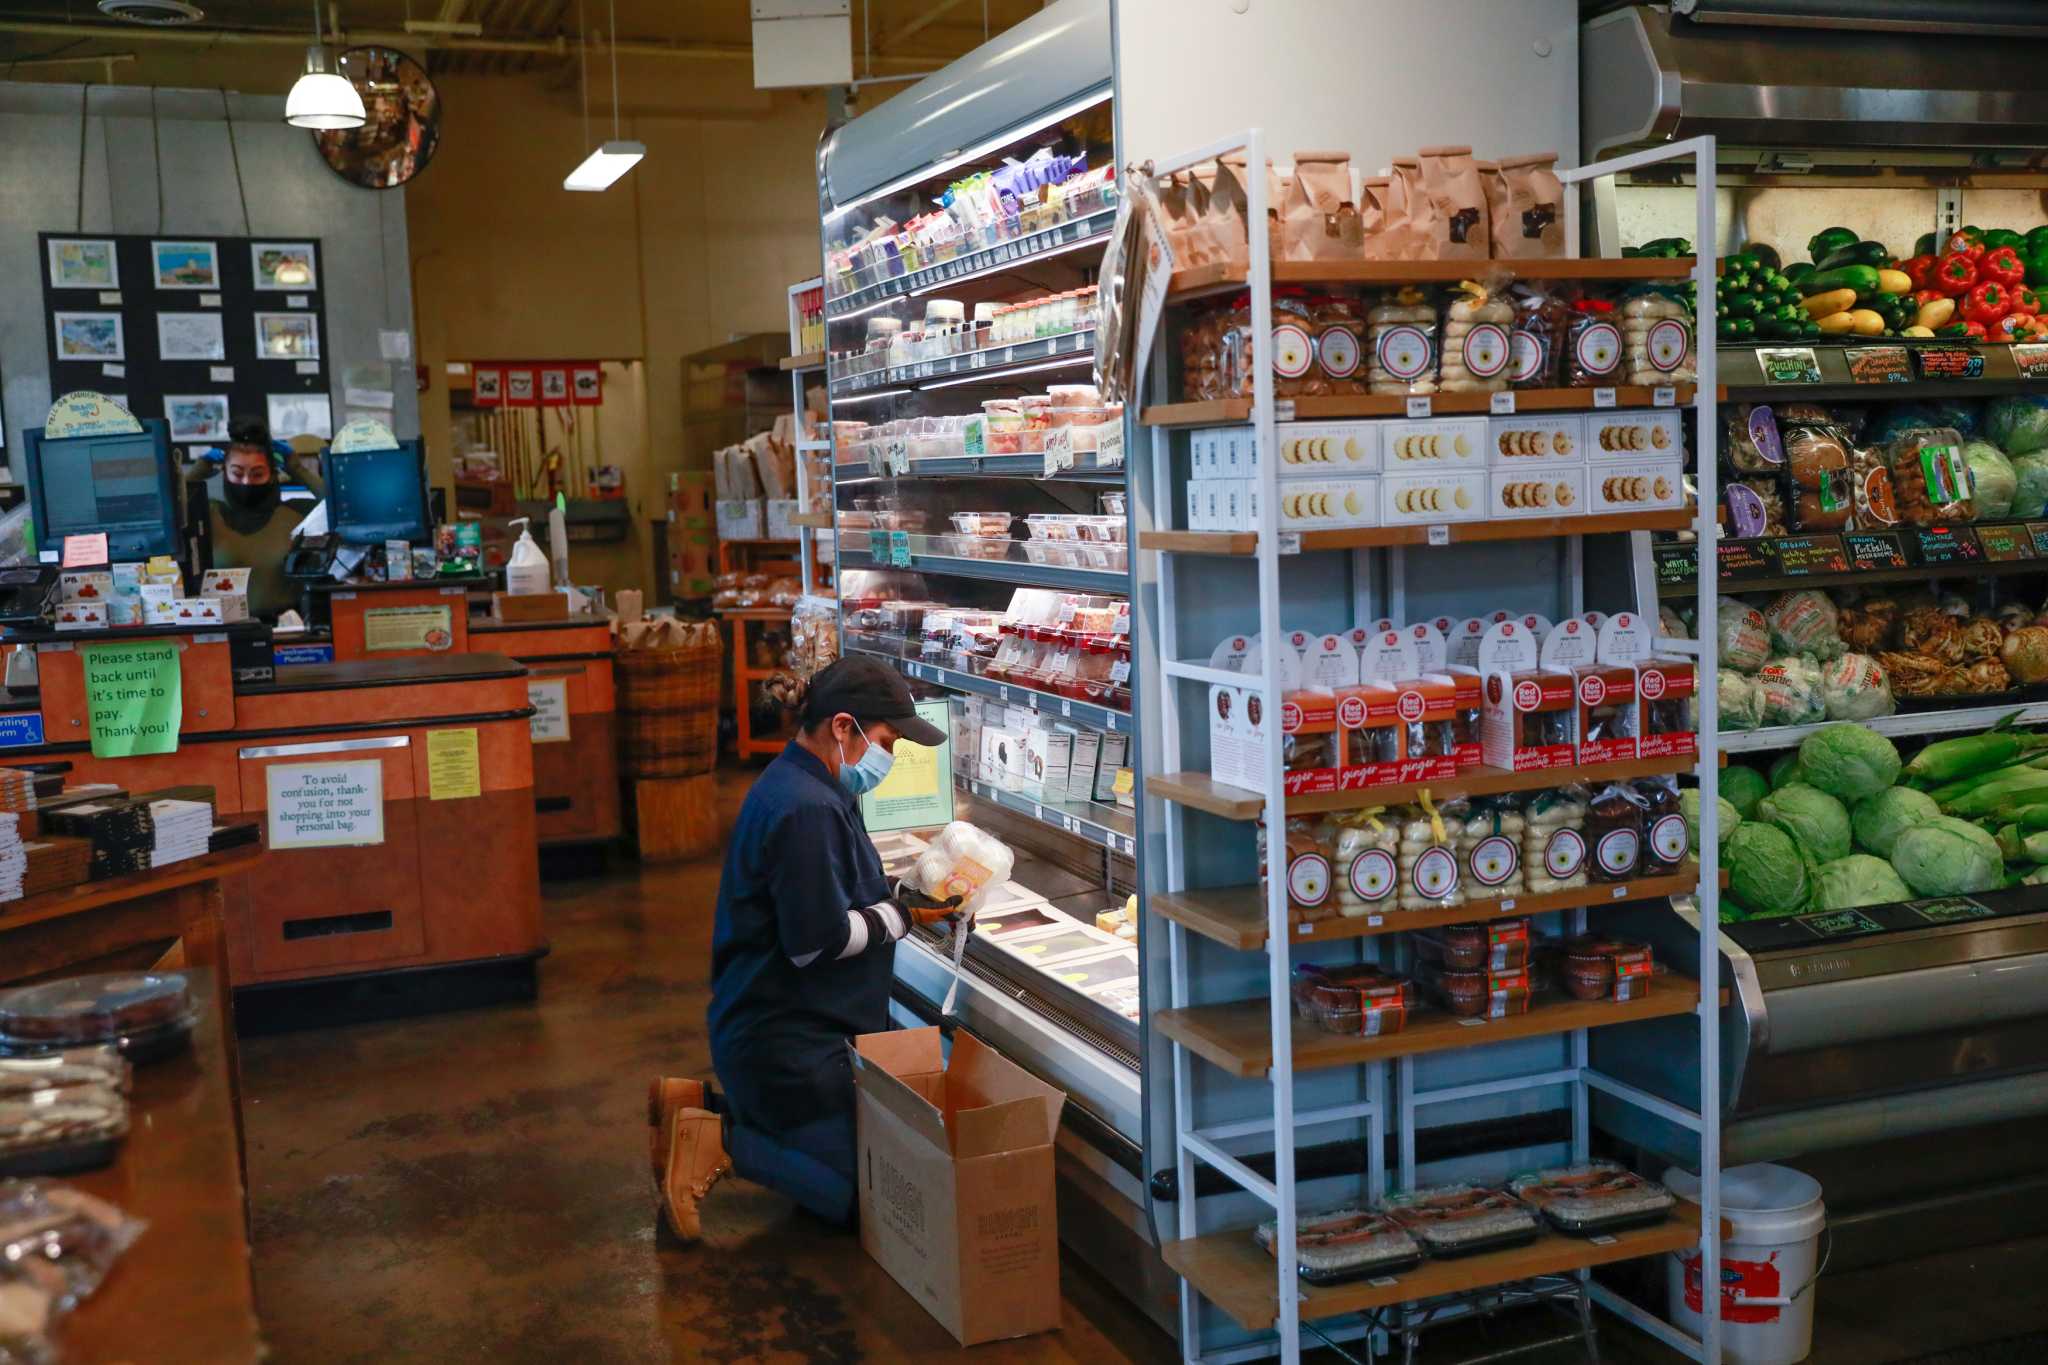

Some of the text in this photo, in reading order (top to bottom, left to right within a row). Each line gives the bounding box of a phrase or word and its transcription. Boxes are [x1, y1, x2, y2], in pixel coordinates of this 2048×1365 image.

[89, 648, 173, 664] Please stand
[91, 668, 156, 683] back until
[93, 687, 165, 701] it's time to
[95, 709, 123, 722] pay.
[96, 721, 169, 738] Thank you!
[302, 773, 347, 785] To avoid
[1340, 765, 1378, 791] ginger
[1399, 759, 1436, 784] ginger
[281, 783, 368, 799] confusion, thank-
[298, 798, 353, 810] you for not
[279, 809, 371, 823] shopping into your
[295, 820, 356, 835] personal bag.
